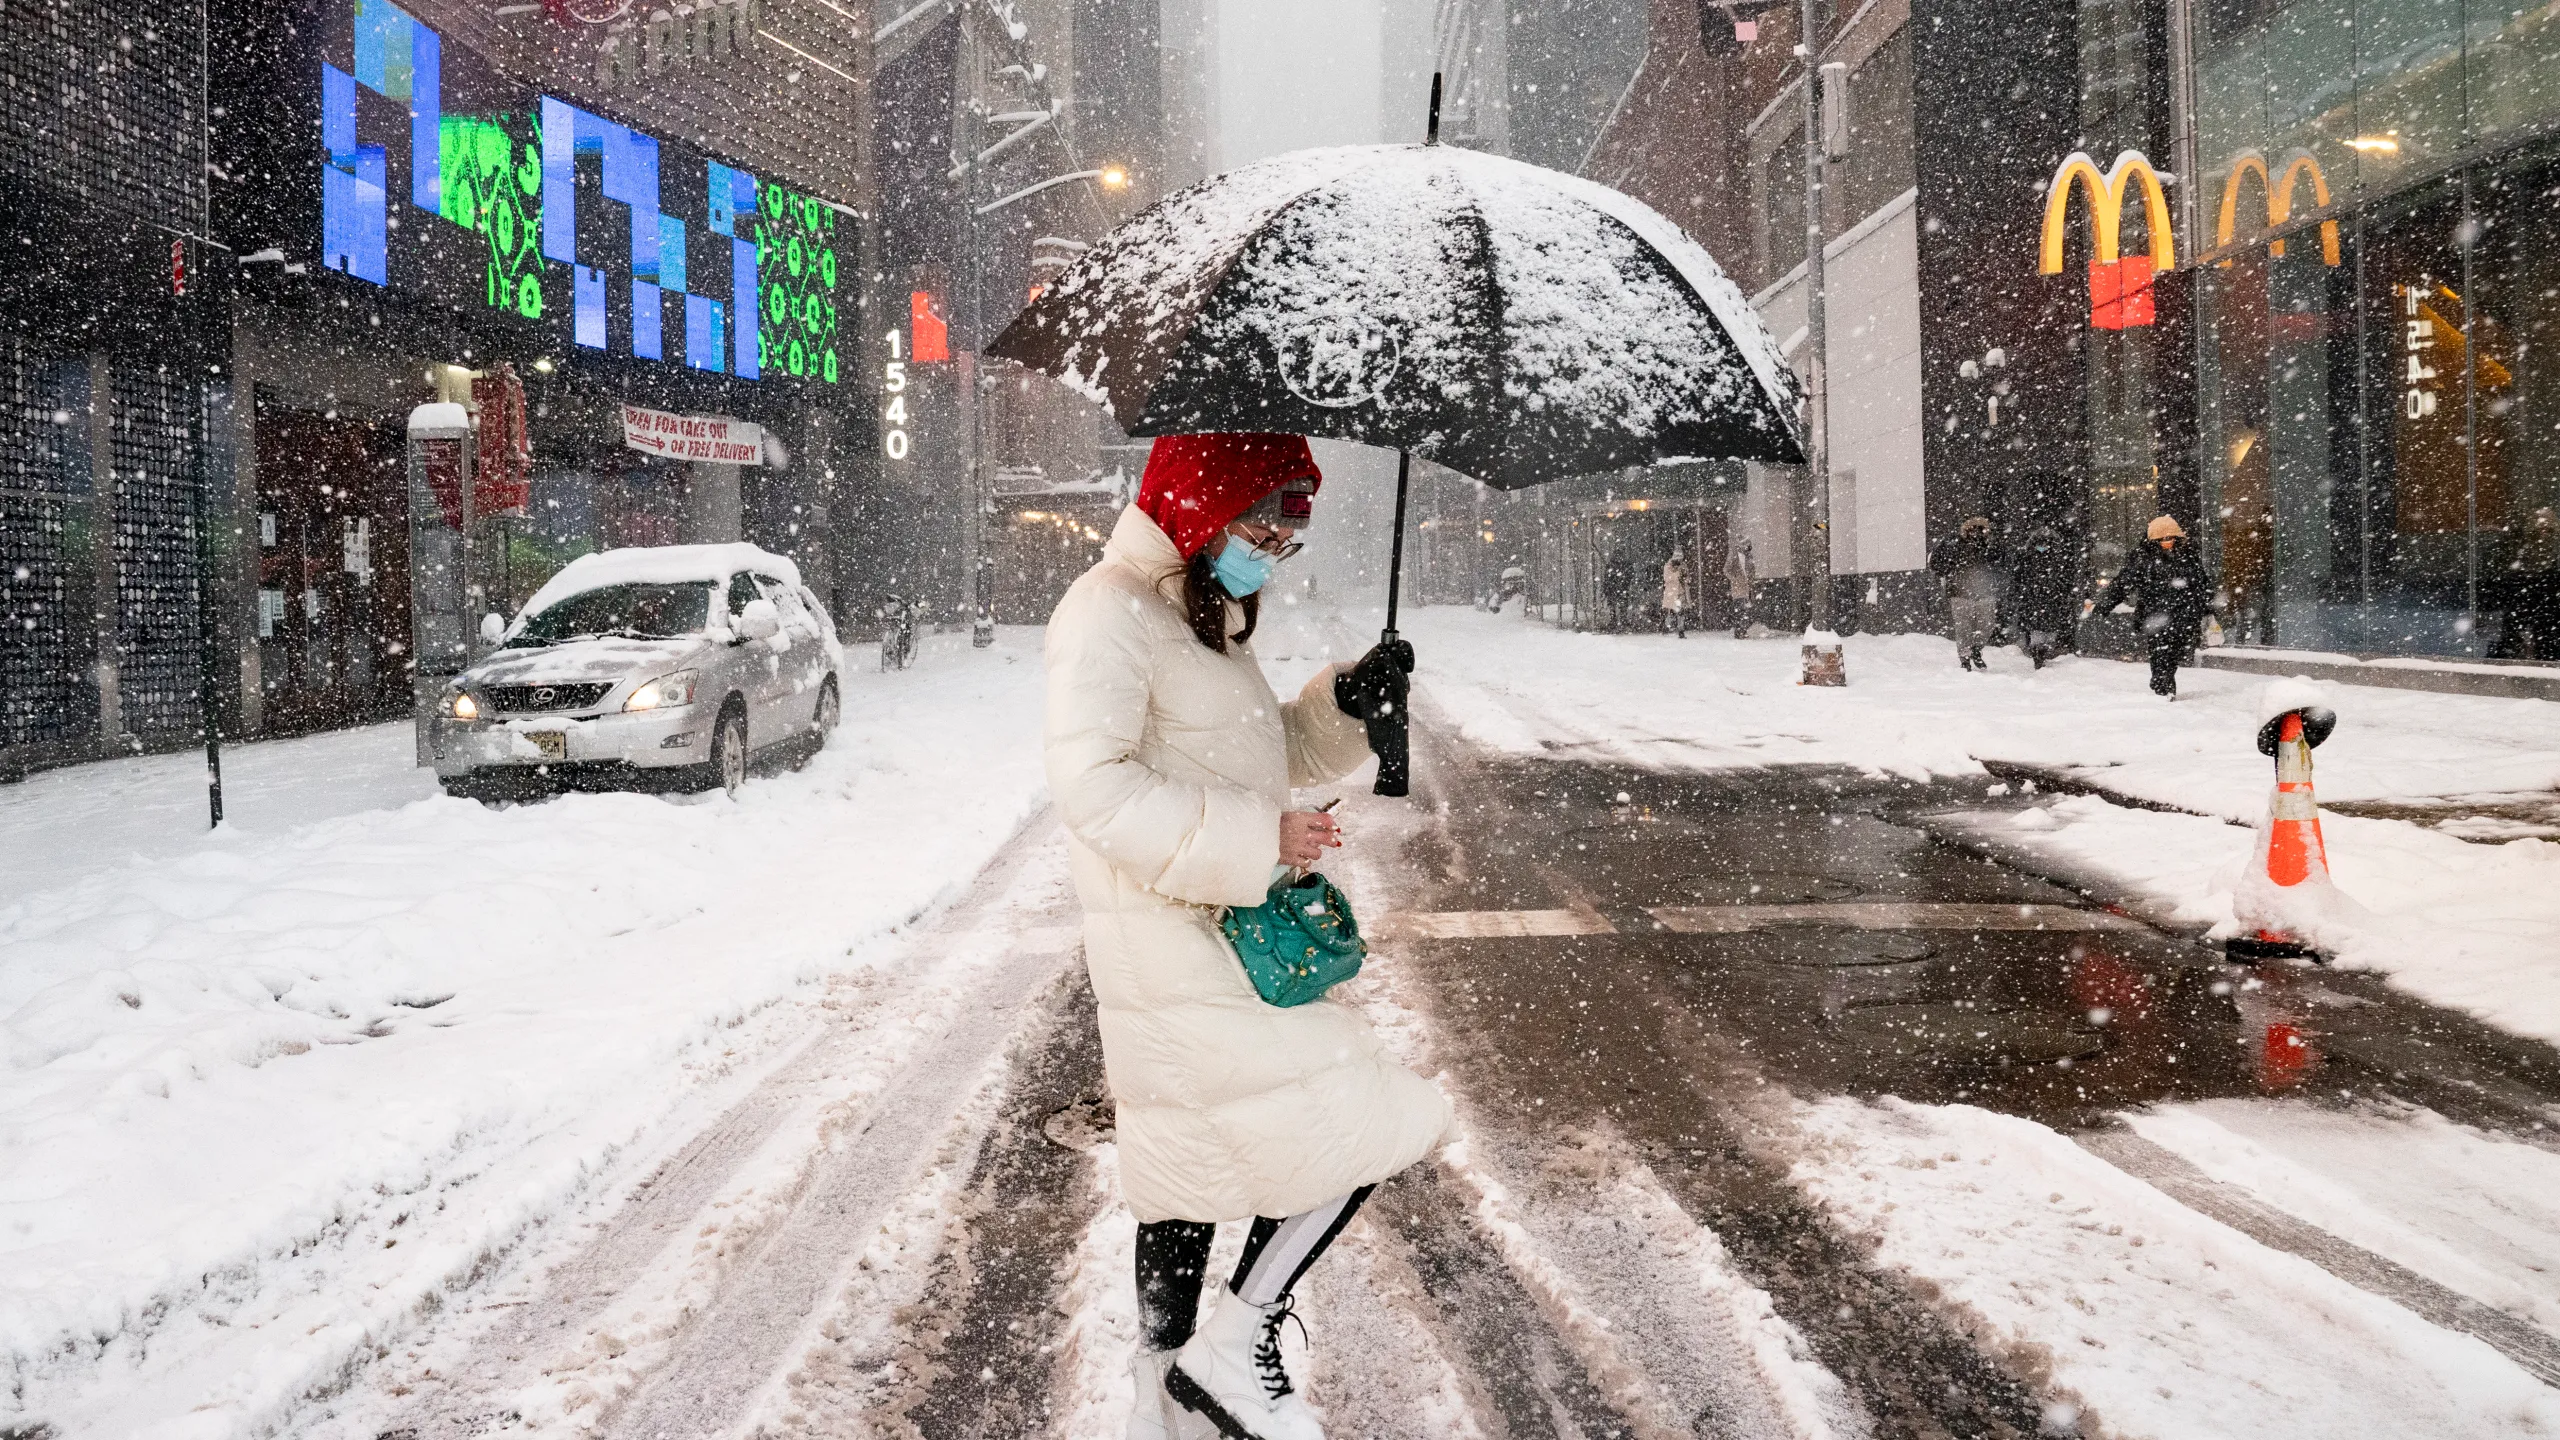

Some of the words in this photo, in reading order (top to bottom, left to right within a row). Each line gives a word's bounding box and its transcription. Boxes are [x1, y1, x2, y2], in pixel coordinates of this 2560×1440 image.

[885, 329, 908, 460] 1540
[655, 415, 678, 434] FOR
[680, 420, 706, 438] TAKE
[709, 423, 728, 439] OUT
[671, 439, 685, 453] OR
[688, 440, 710, 458] FREE
[713, 442, 756, 461] DELIVERY
